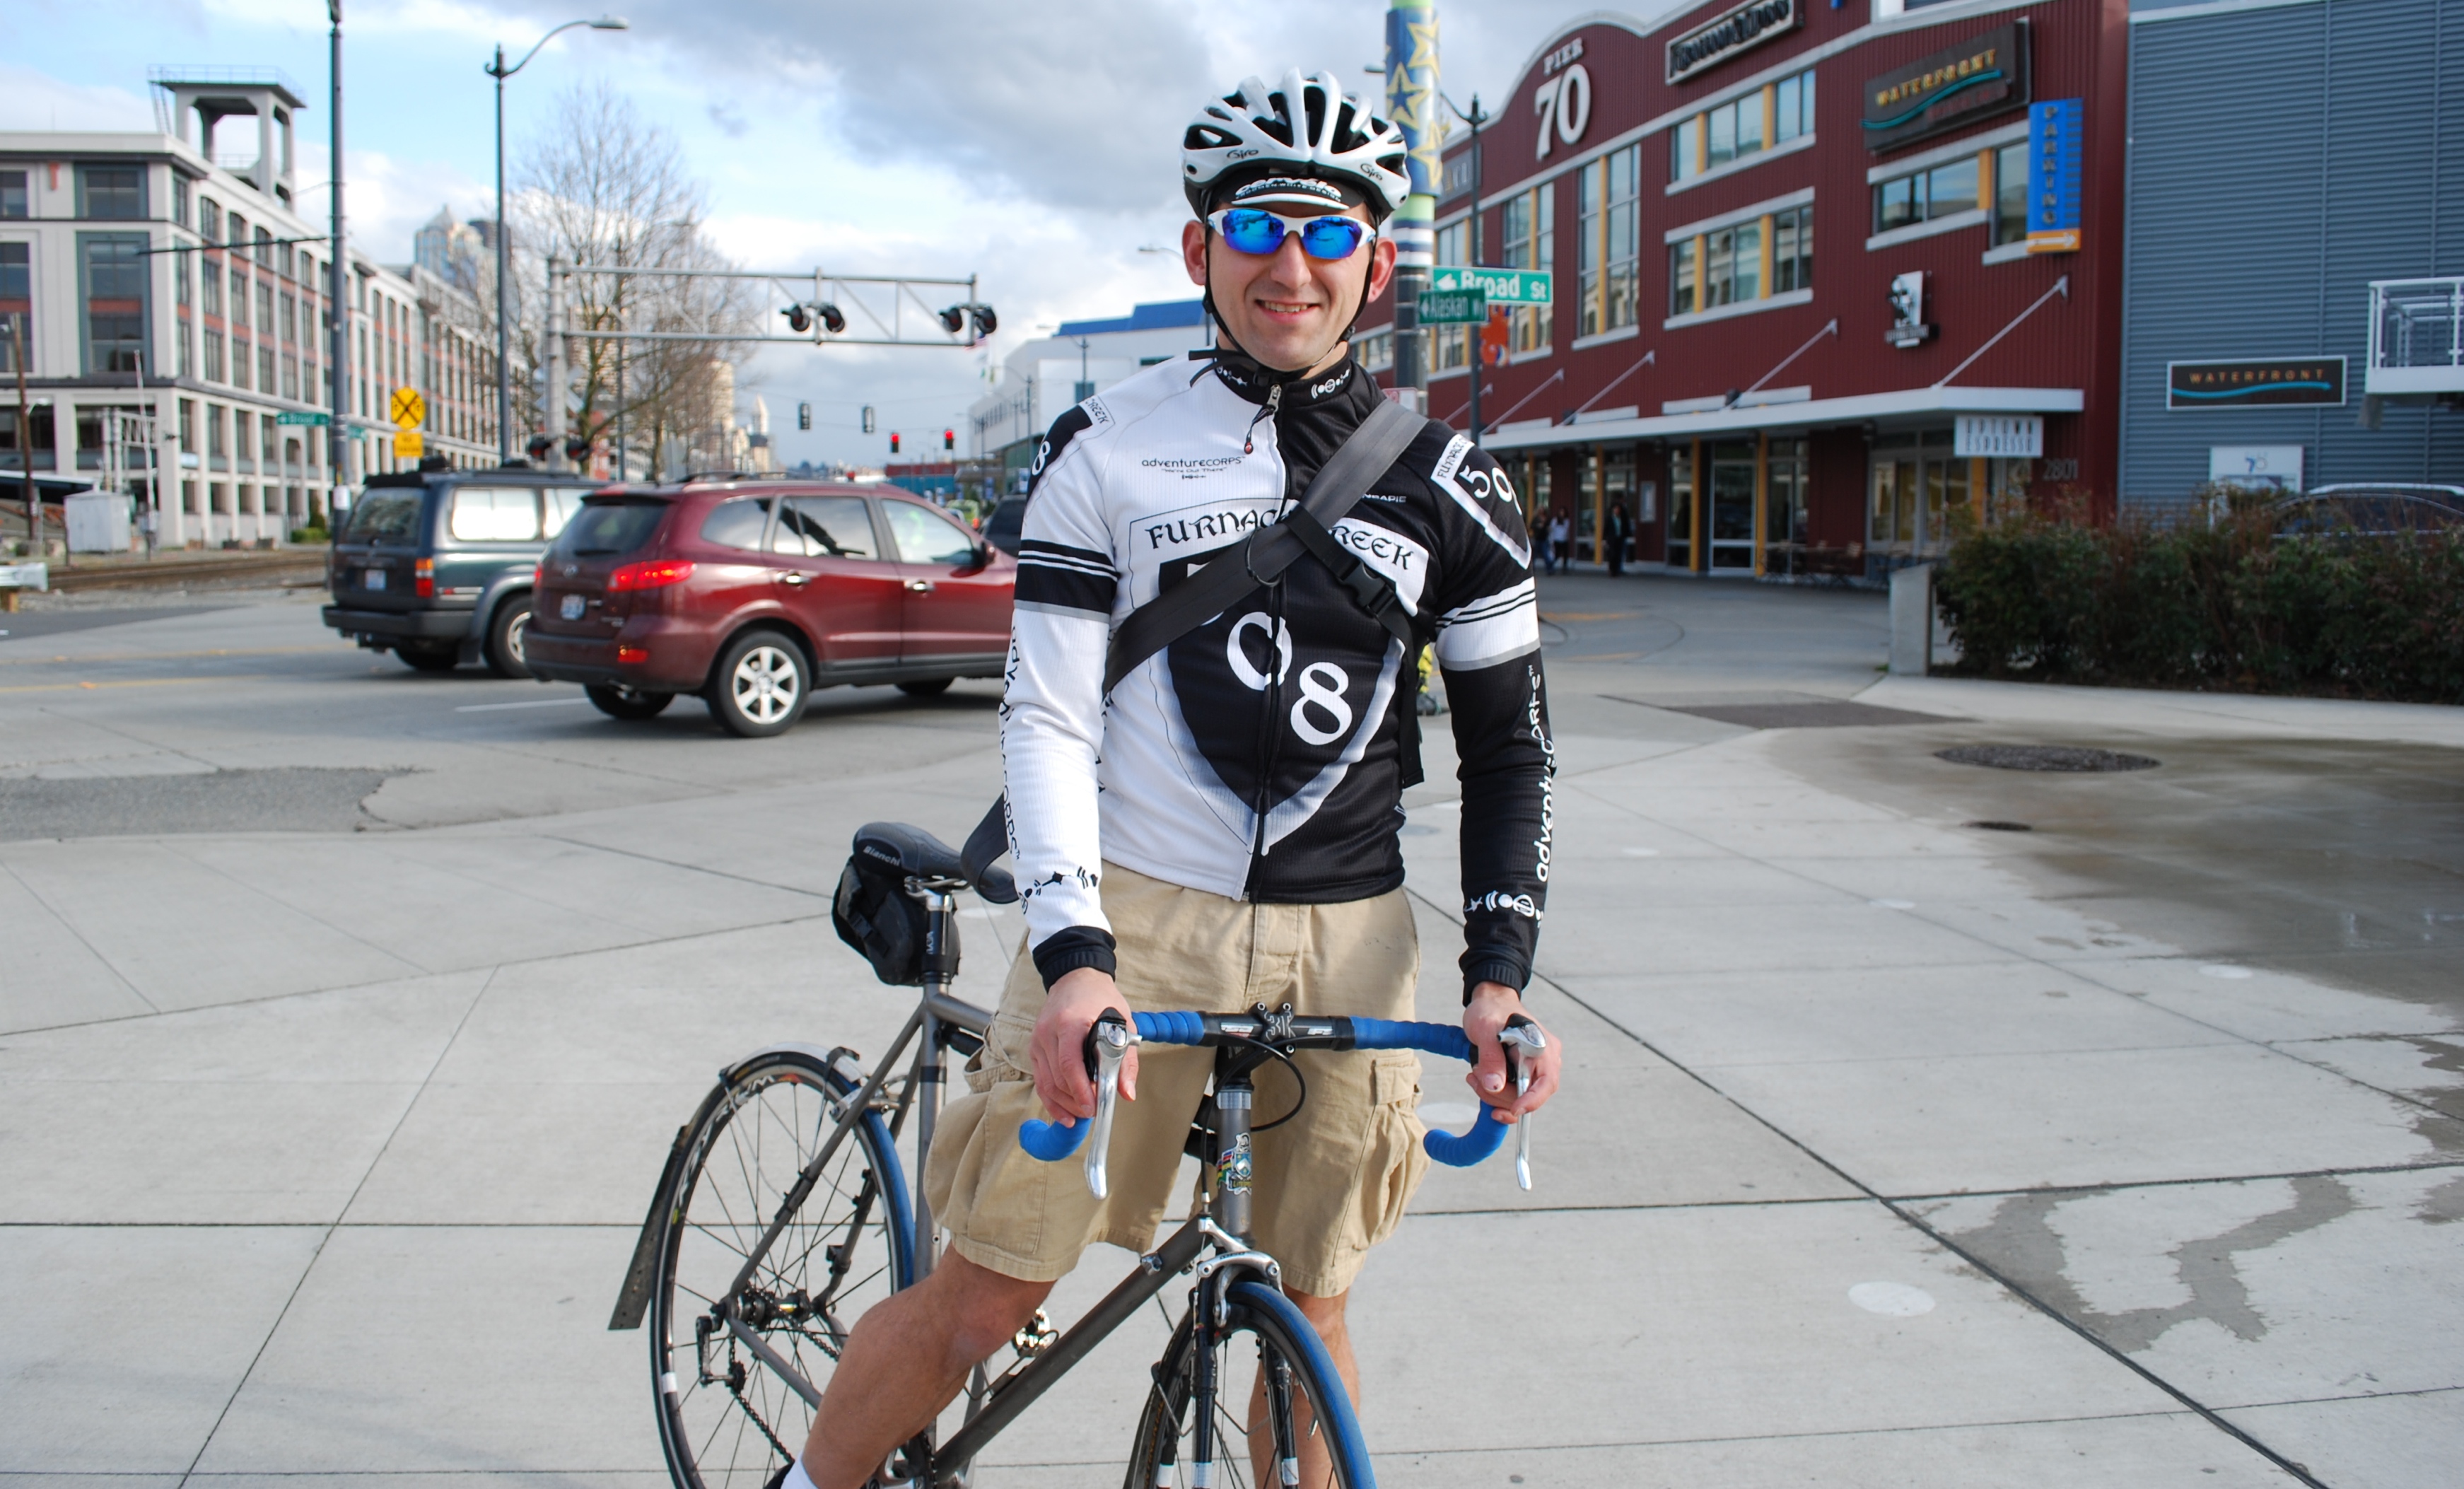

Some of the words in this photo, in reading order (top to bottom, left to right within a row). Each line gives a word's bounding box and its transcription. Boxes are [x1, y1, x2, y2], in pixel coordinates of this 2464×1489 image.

[1543, 37, 1584, 76] PIER
[1876, 48, 1997, 106] WATERFRONT
[1534, 64, 1591, 163] 70
[1227, 148, 1259, 160] Giro
[2042, 105, 2059, 224] PARKING
[1360, 163, 1383, 180] Giro
[1461, 270, 1520, 298] Broad
[1530, 281, 1547, 300] St
[1430, 294, 1469, 318] Alaskan
[2189, 368, 2325, 385] WATERFRONT
[1966, 436, 2033, 452] ESPRESSO
[2043, 460, 2078, 481] 2801
[1459, 465, 1522, 515] 50
[1145, 507, 1293, 549] FURNAC
[1330, 525, 1415, 571] REEK
[863, 845, 901, 867] Bianchi
